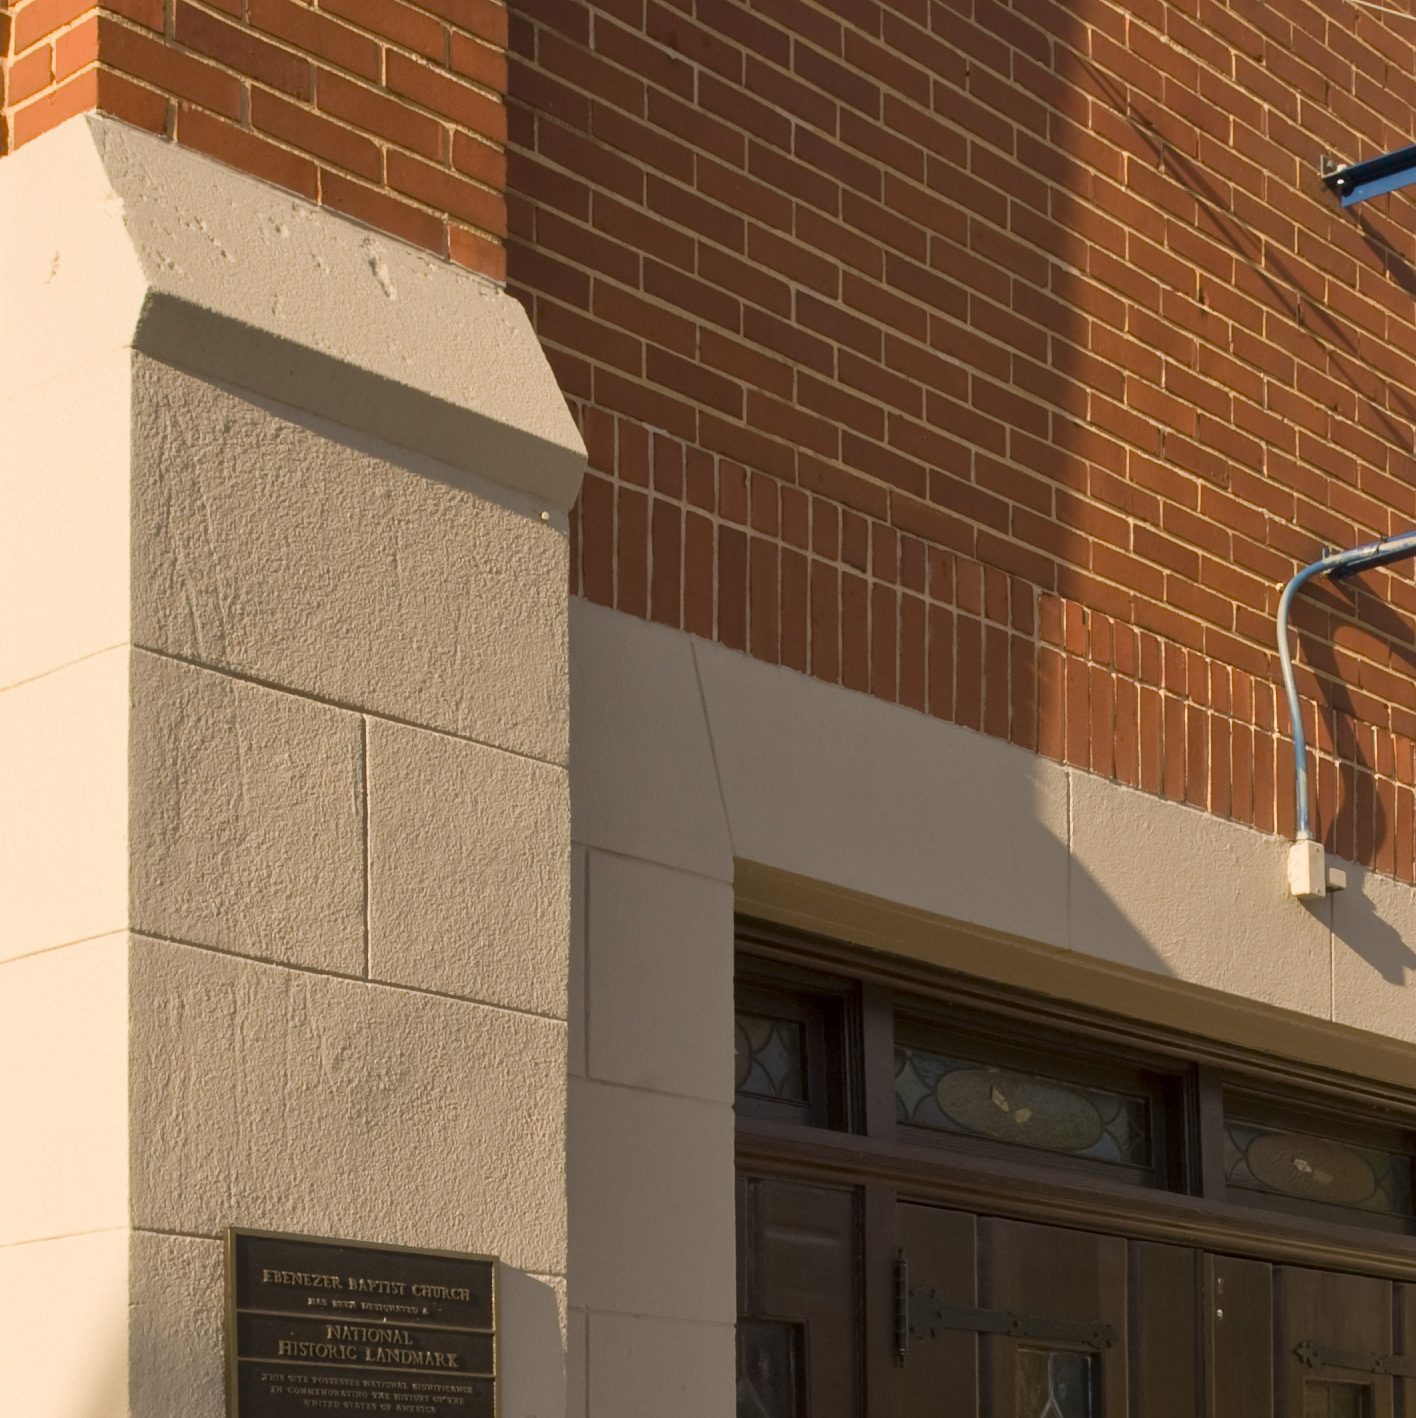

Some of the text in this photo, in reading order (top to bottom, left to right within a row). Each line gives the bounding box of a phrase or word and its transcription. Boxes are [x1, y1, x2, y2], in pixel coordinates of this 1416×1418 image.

[263, 1269, 470, 1301] EBENEZER BAPTIST CHURCH
[326, 1325, 413, 1345] NATIONAL
[278, 1340, 458, 1367] HISTORIC LANDMARK
